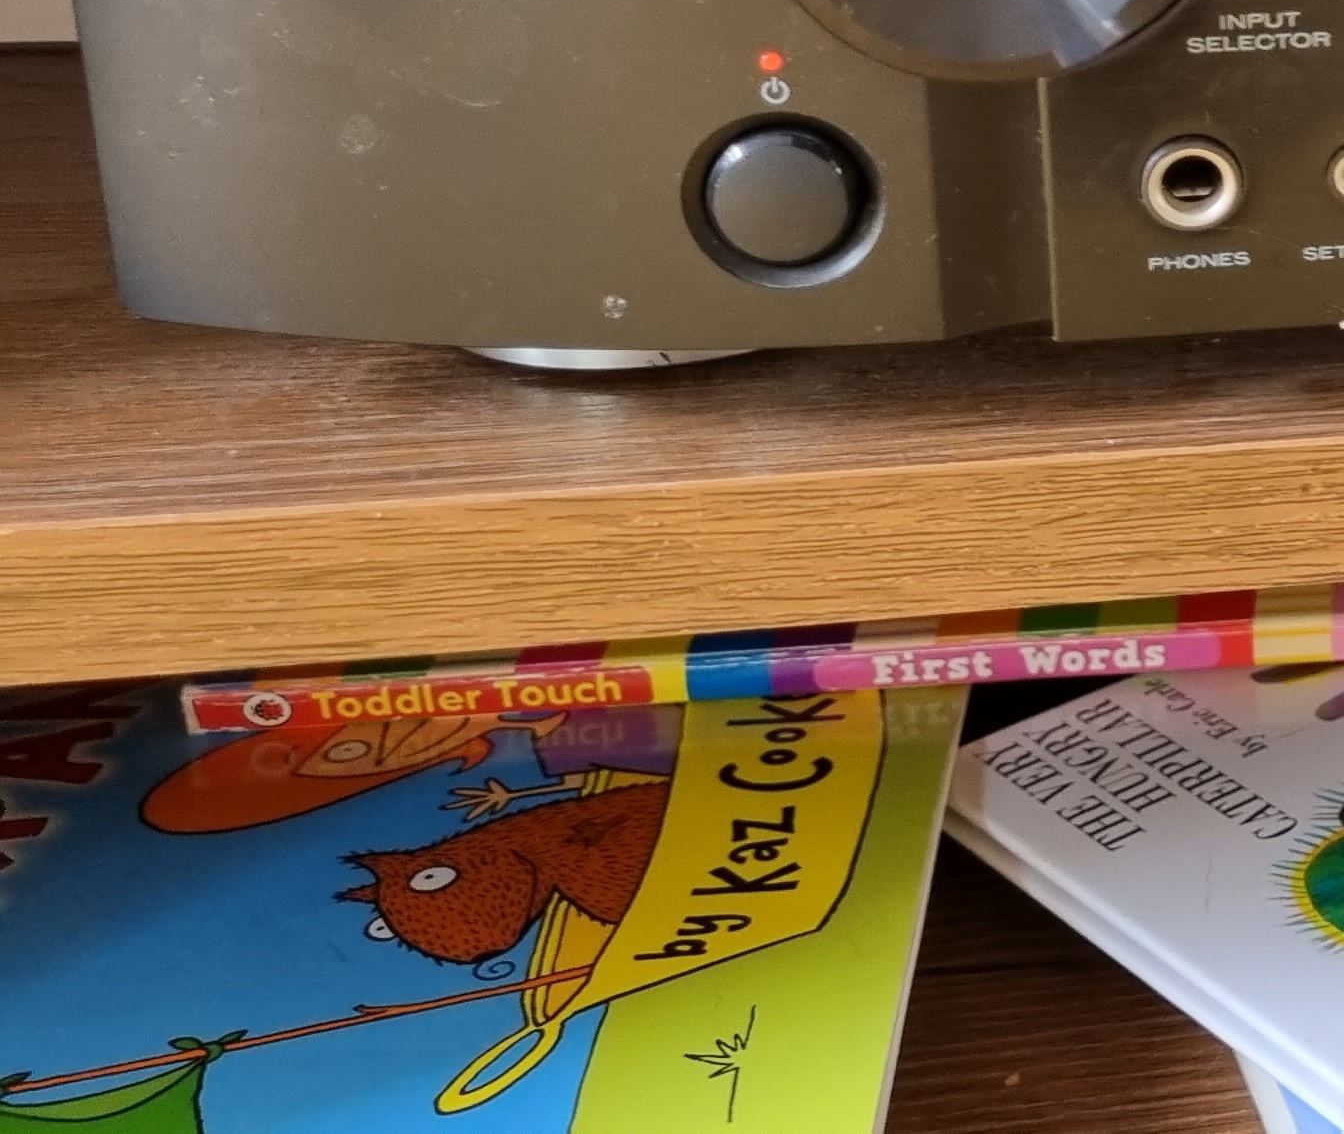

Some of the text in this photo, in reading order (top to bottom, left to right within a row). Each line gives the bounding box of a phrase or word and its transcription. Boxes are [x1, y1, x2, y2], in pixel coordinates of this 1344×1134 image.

[1186, 31, 1332, 54] SELECTOR
[1218, 11, 1301, 31] INPUT
[1148, 251, 1251, 271] PHONES
[871, 639, 1167, 685] First Words
[311, 676, 623, 719] Toddler Touch
[1192, 708, 1240, 740] Eric
[1022, 720, 1177, 814] HUNGRY
[1233, 734, 1269, 758] by
[1074, 697, 1298, 841] CATERPILLAR
[972, 741, 1147, 852] THE VERY
[633, 693, 846, 961] by Kaz Cook
